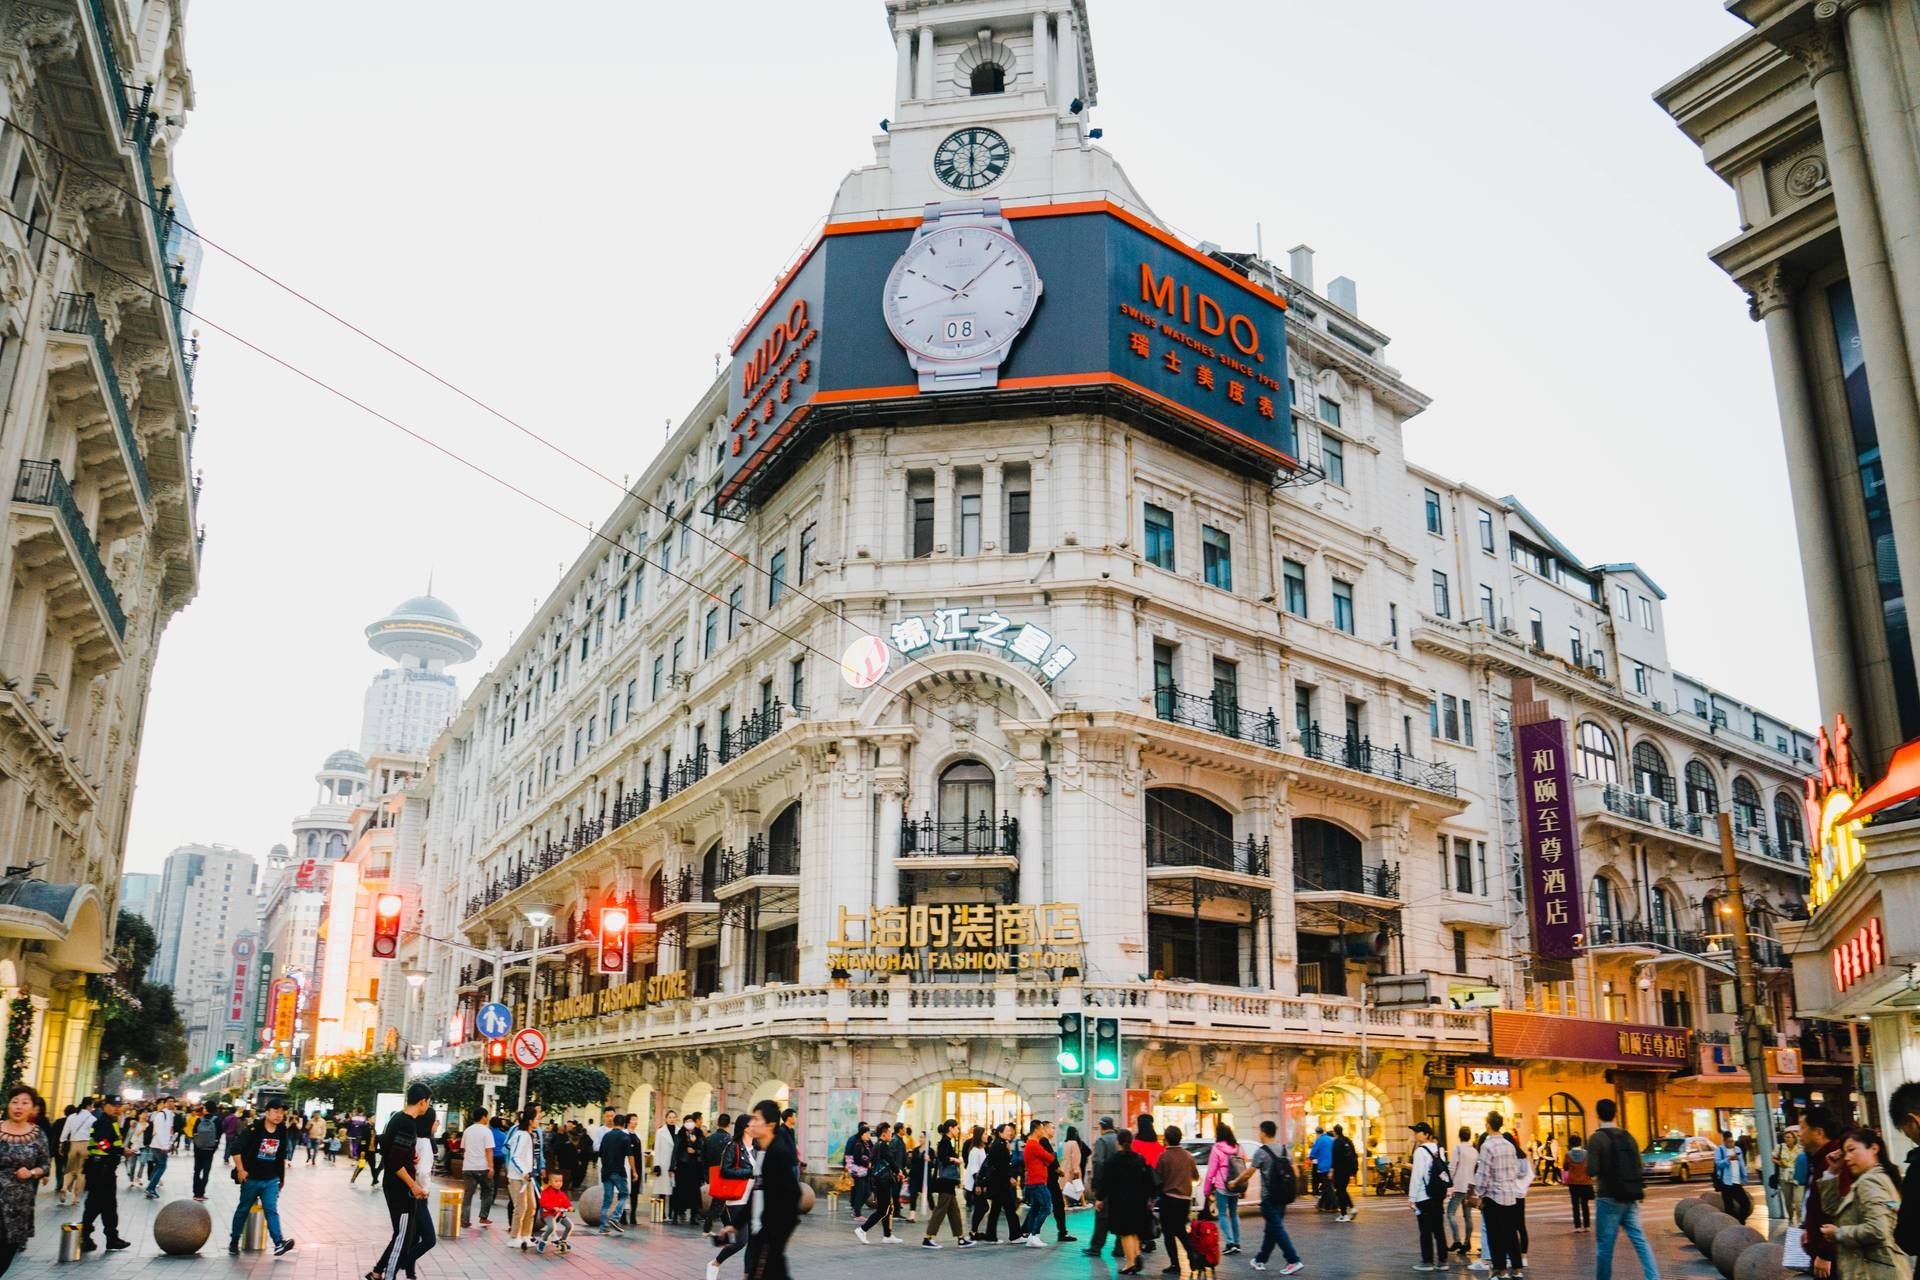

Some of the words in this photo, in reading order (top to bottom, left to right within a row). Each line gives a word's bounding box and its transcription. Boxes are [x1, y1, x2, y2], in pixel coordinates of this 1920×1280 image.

[947, 321, 972, 338] 08
[1120, 303, 1157, 328] SWISS
[1160, 324, 1216, 358] WATCHES
[1219, 353, 1254, 377] SINCE
[1129, 331, 1274, 420] 瑞士美度表
[1530, 748, 1569, 927] 和颐至尊酒店
[826, 902, 1083, 948] 上海时装商店
[825, 952, 921, 971] SHANGHAI
[928, 951, 1011, 970] FASHION
[1018, 951, 1082, 969] STORE
[599, 980, 642, 1013] FASHION
[648, 970, 687, 1002] STORE
[1618, 1031, 1686, 1058] 和颐至尊酒店
